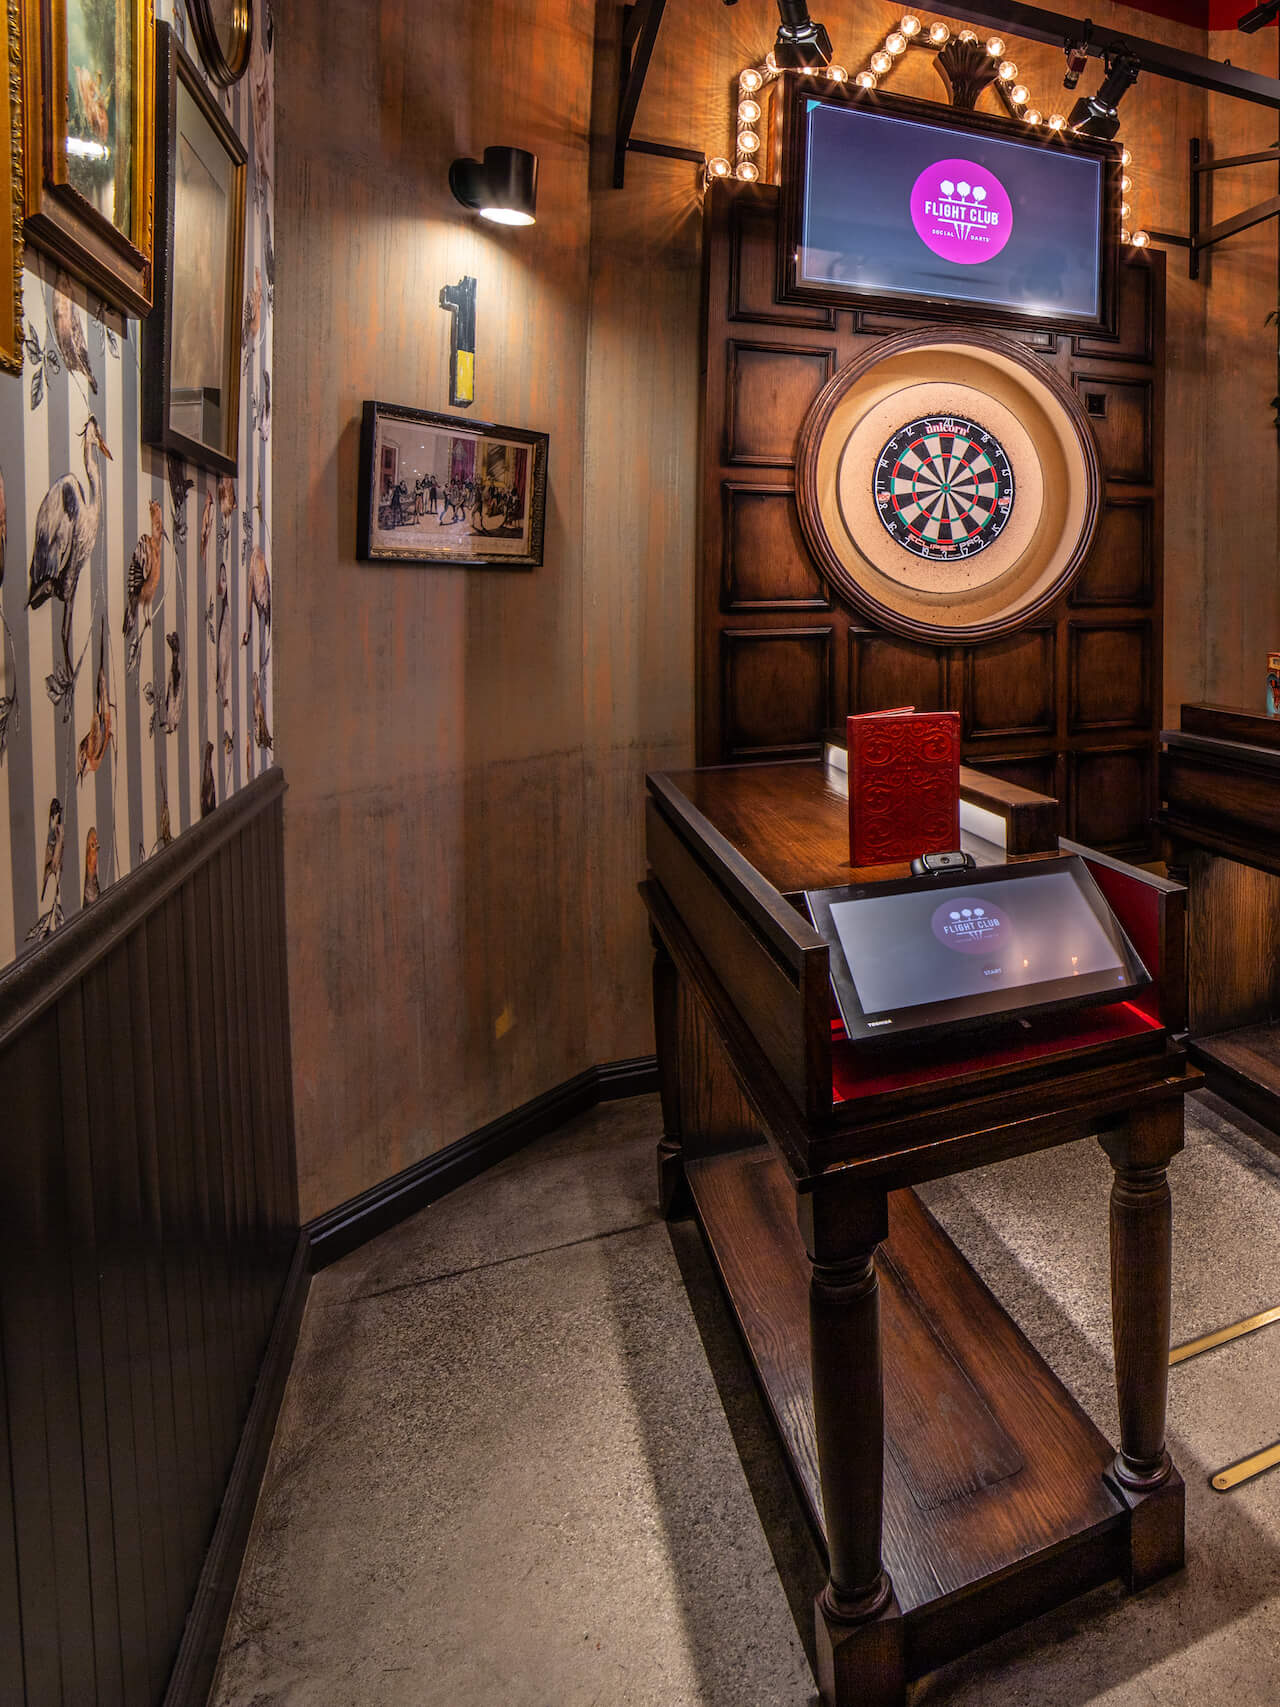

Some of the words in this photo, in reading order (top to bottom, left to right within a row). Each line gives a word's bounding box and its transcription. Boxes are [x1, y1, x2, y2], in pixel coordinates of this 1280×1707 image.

[925, 201, 967, 220] FLIGHT
[969, 207, 999, 226] CLUB
[932, 229, 954, 237] SOCIAL
[971, 235, 989, 243] DARTS
[439, 275, 477, 408] 1
[925, 422, 967, 436] unicorn
[943, 921, 976, 935] FLIGHT
[976, 918, 1000, 930] CLUB
